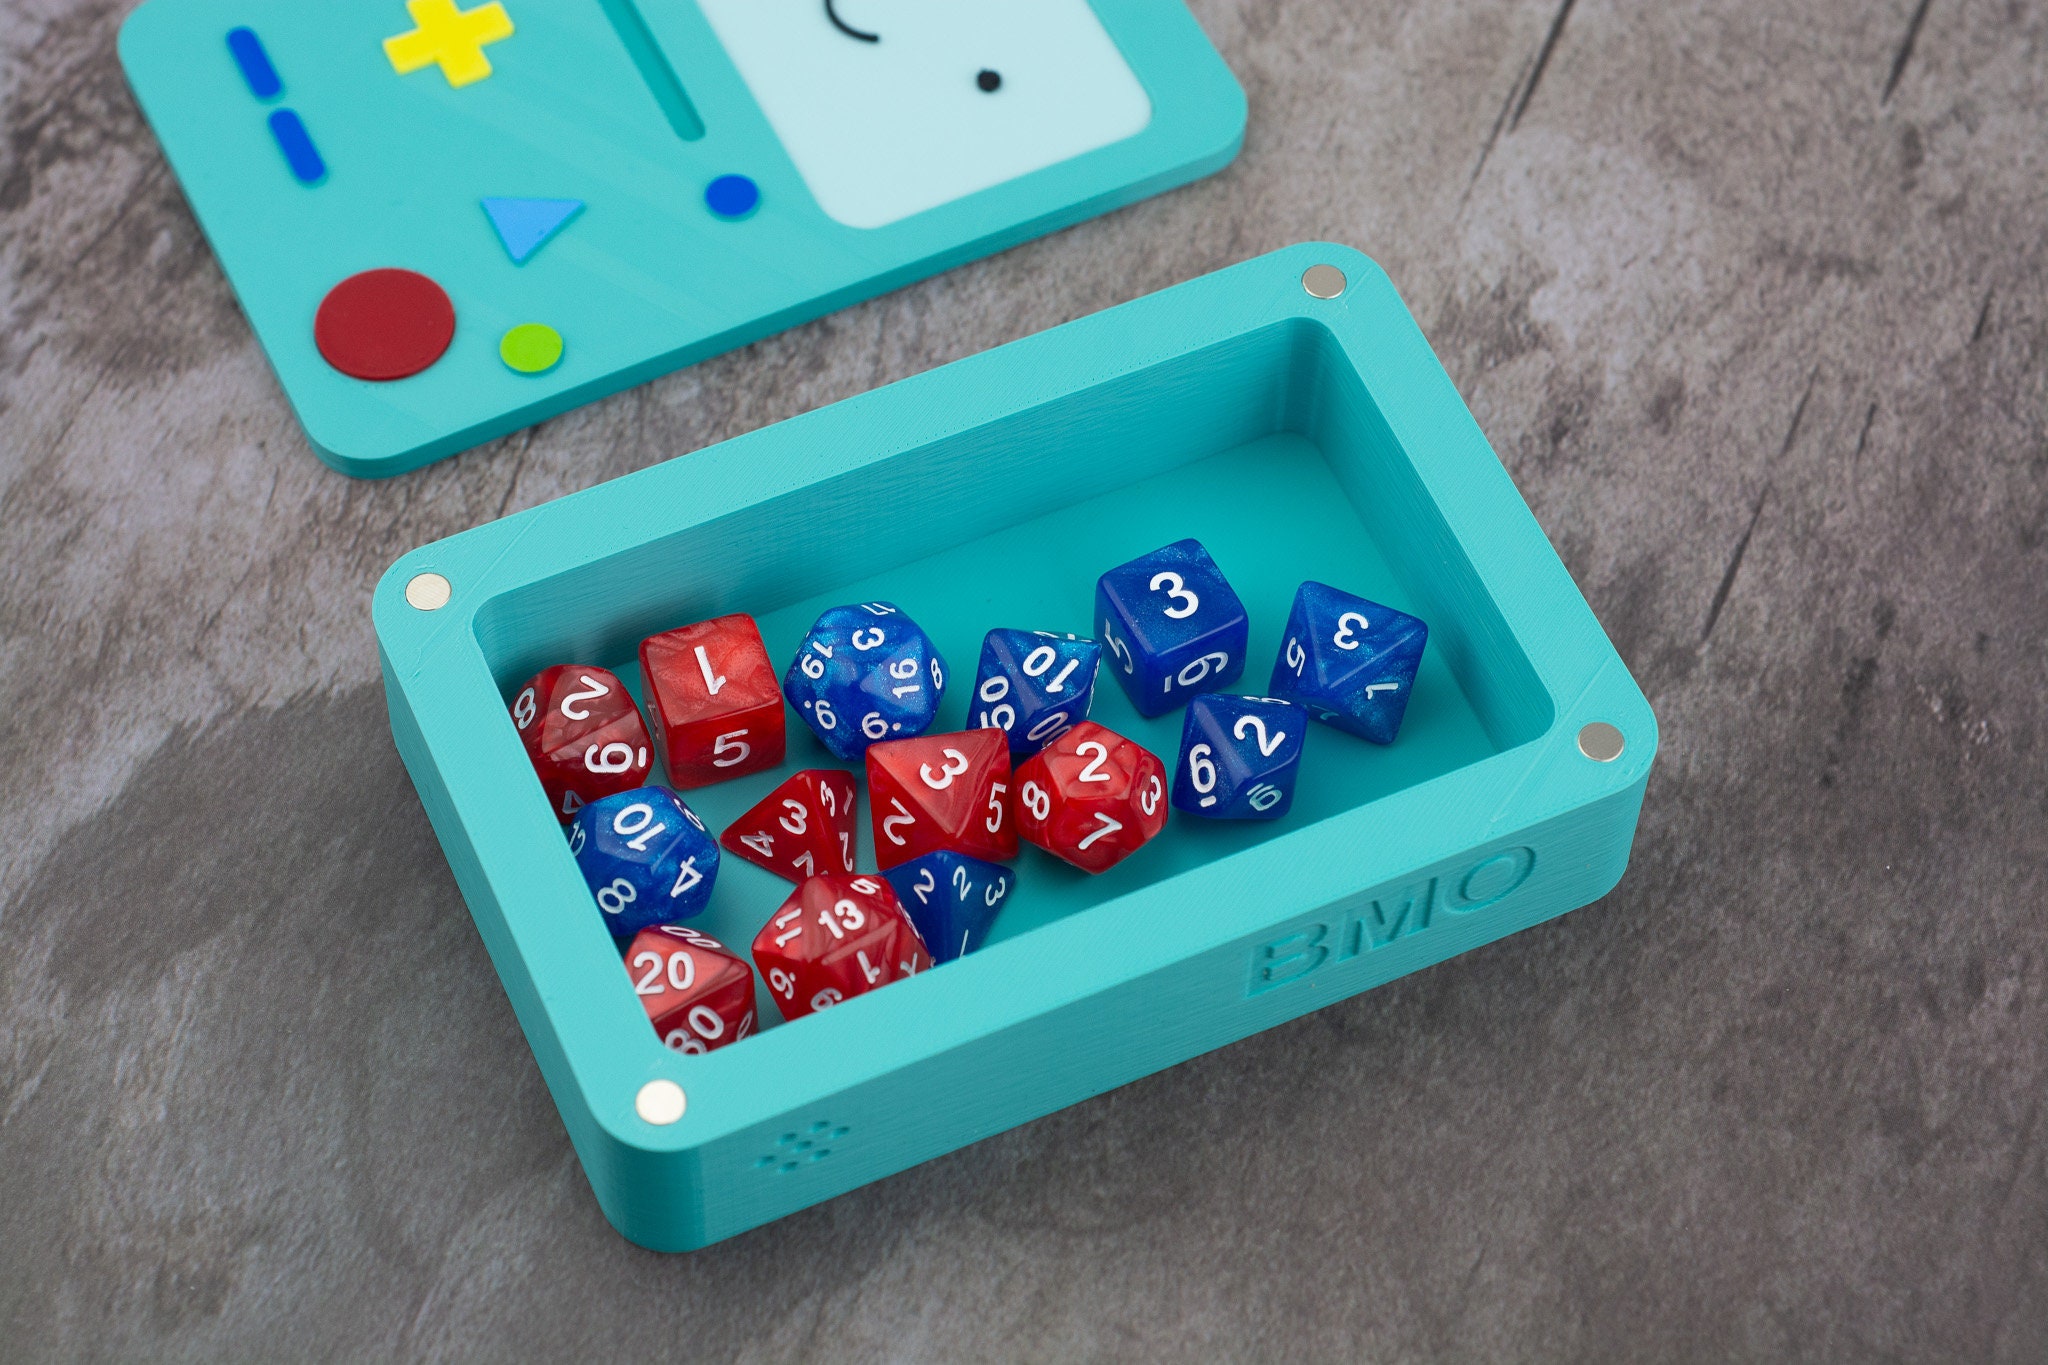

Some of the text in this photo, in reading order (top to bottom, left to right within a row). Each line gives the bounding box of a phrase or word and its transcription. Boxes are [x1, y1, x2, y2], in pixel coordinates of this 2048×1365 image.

[1149, 571, 1199, 619] 3
[852, 627, 886, 651] 3
[1105, 618, 1134, 675] 5
[1333, 612, 1369, 650] 3
[694, 645, 727, 696] 1
[801, 641, 834, 679] 19
[931, 658, 943, 690] 8
[1022, 645, 1079, 693] 10
[1286, 637, 1306, 678] 5
[561, 675, 610, 720] 2
[889, 658, 920, 699] 16
[1365, 682, 1399, 700] 1
[514, 687, 537, 730] 8
[713, 729, 750, 768] 5
[1233, 715, 1286, 757] 2
[919, 748, 969, 790] 3
[1075, 741, 1111, 782] 2
[820, 780, 836, 817] 3
[986, 782, 1007, 833] 5
[1022, 780, 1050, 821] 8
[1141, 775, 1162, 816] 3
[613, 803, 667, 852] 10
[778, 799, 808, 835] 3
[883, 797, 915, 846] 2
[1078, 811, 1124, 850] 7
[740, 830, 775, 858] 4
[597, 878, 638, 914] 8
[670, 855, 703, 898] 4
[850, 878, 881, 895] 5
[913, 868, 935, 905] 2
[952, 865, 972, 902] 2
[985, 876, 1006, 907] 3
[818, 899, 865, 939] 13
[1245, 846, 1537, 999] BMO
[633, 951, 695, 995] 20
[856, 950, 881, 984] 1
[664, 1005, 725, 1057] 80
